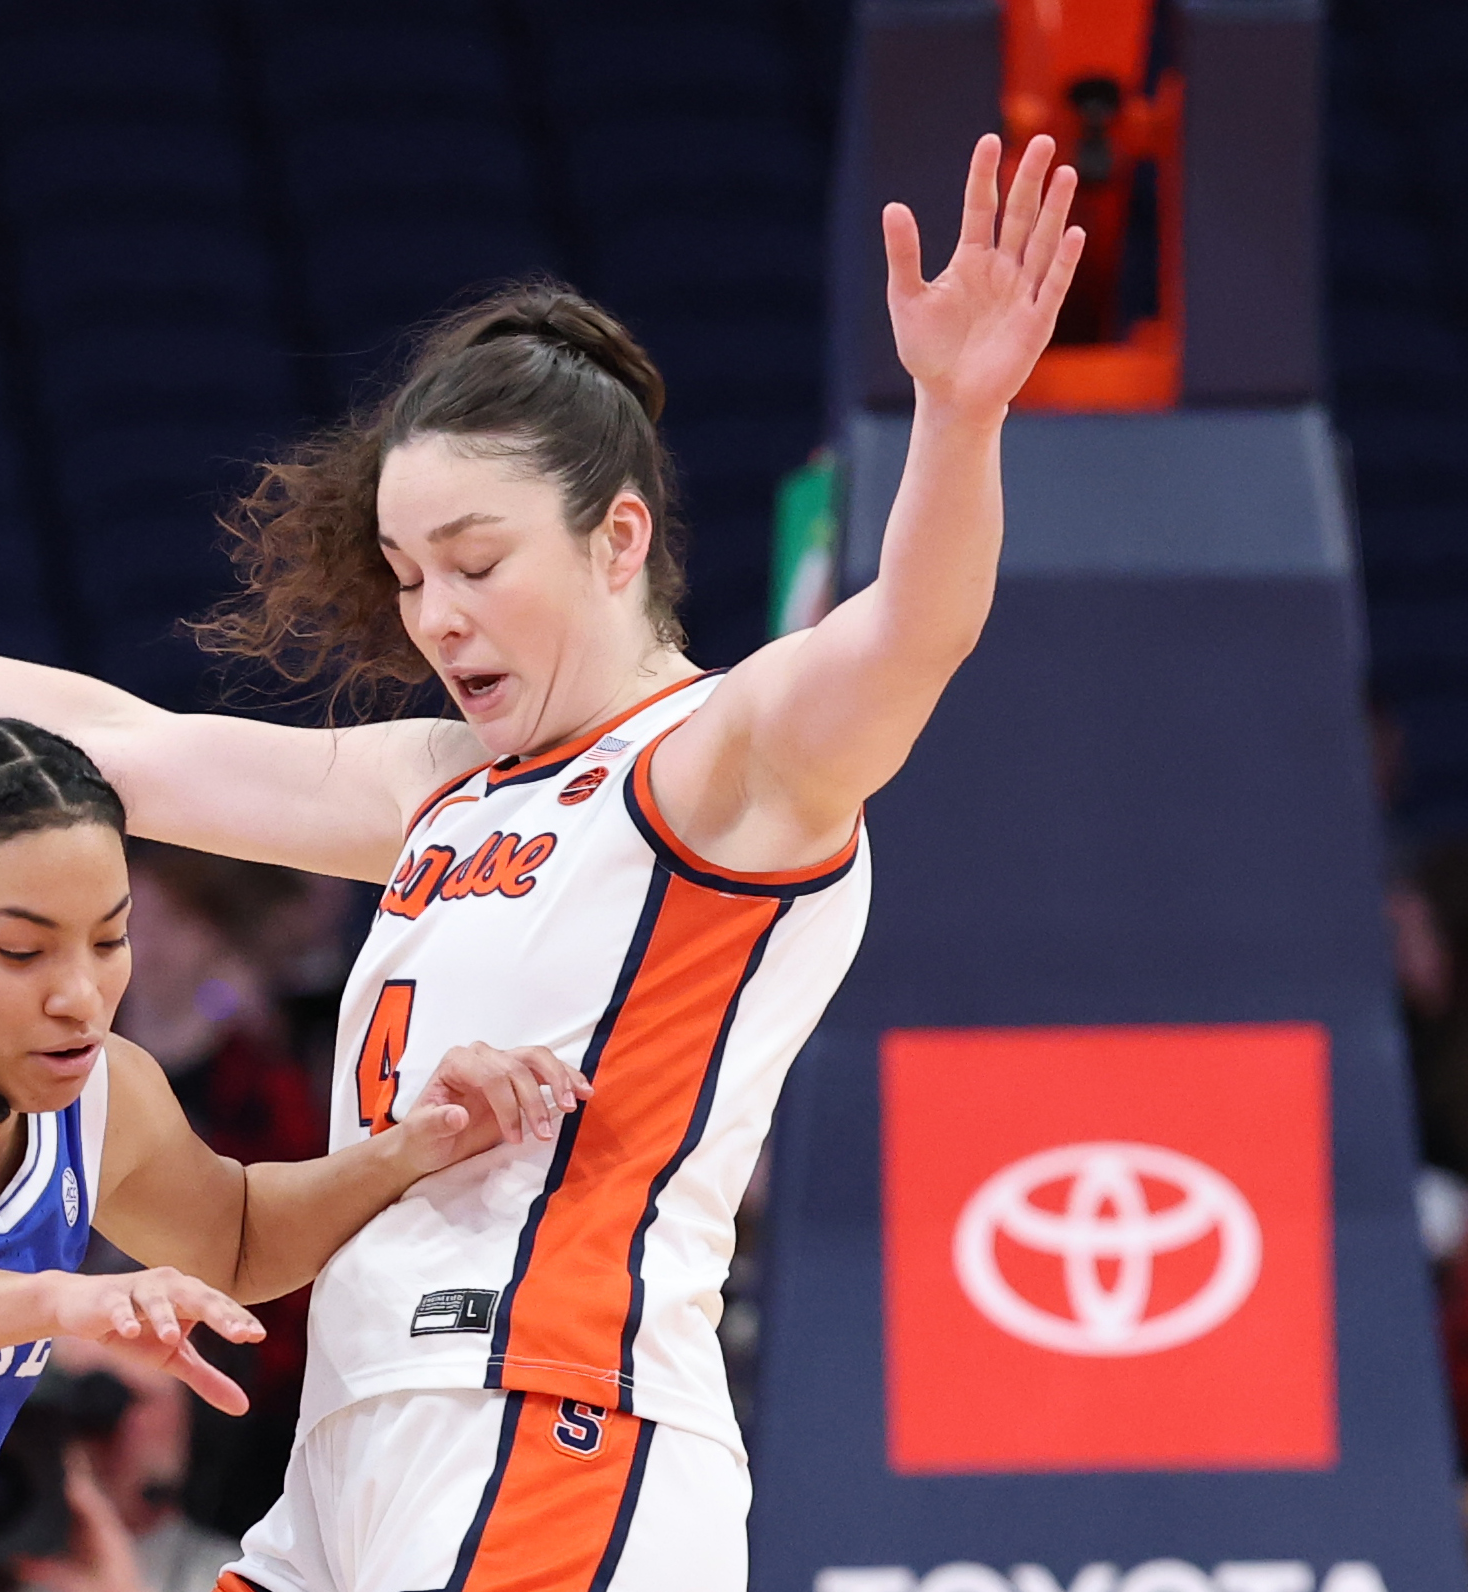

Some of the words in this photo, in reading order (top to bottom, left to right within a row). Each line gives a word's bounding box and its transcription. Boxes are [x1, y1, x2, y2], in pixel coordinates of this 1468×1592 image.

[355, 979, 417, 1137] 4
[466, 1299, 477, 1318] L
[553, 1396, 608, 1455] S
